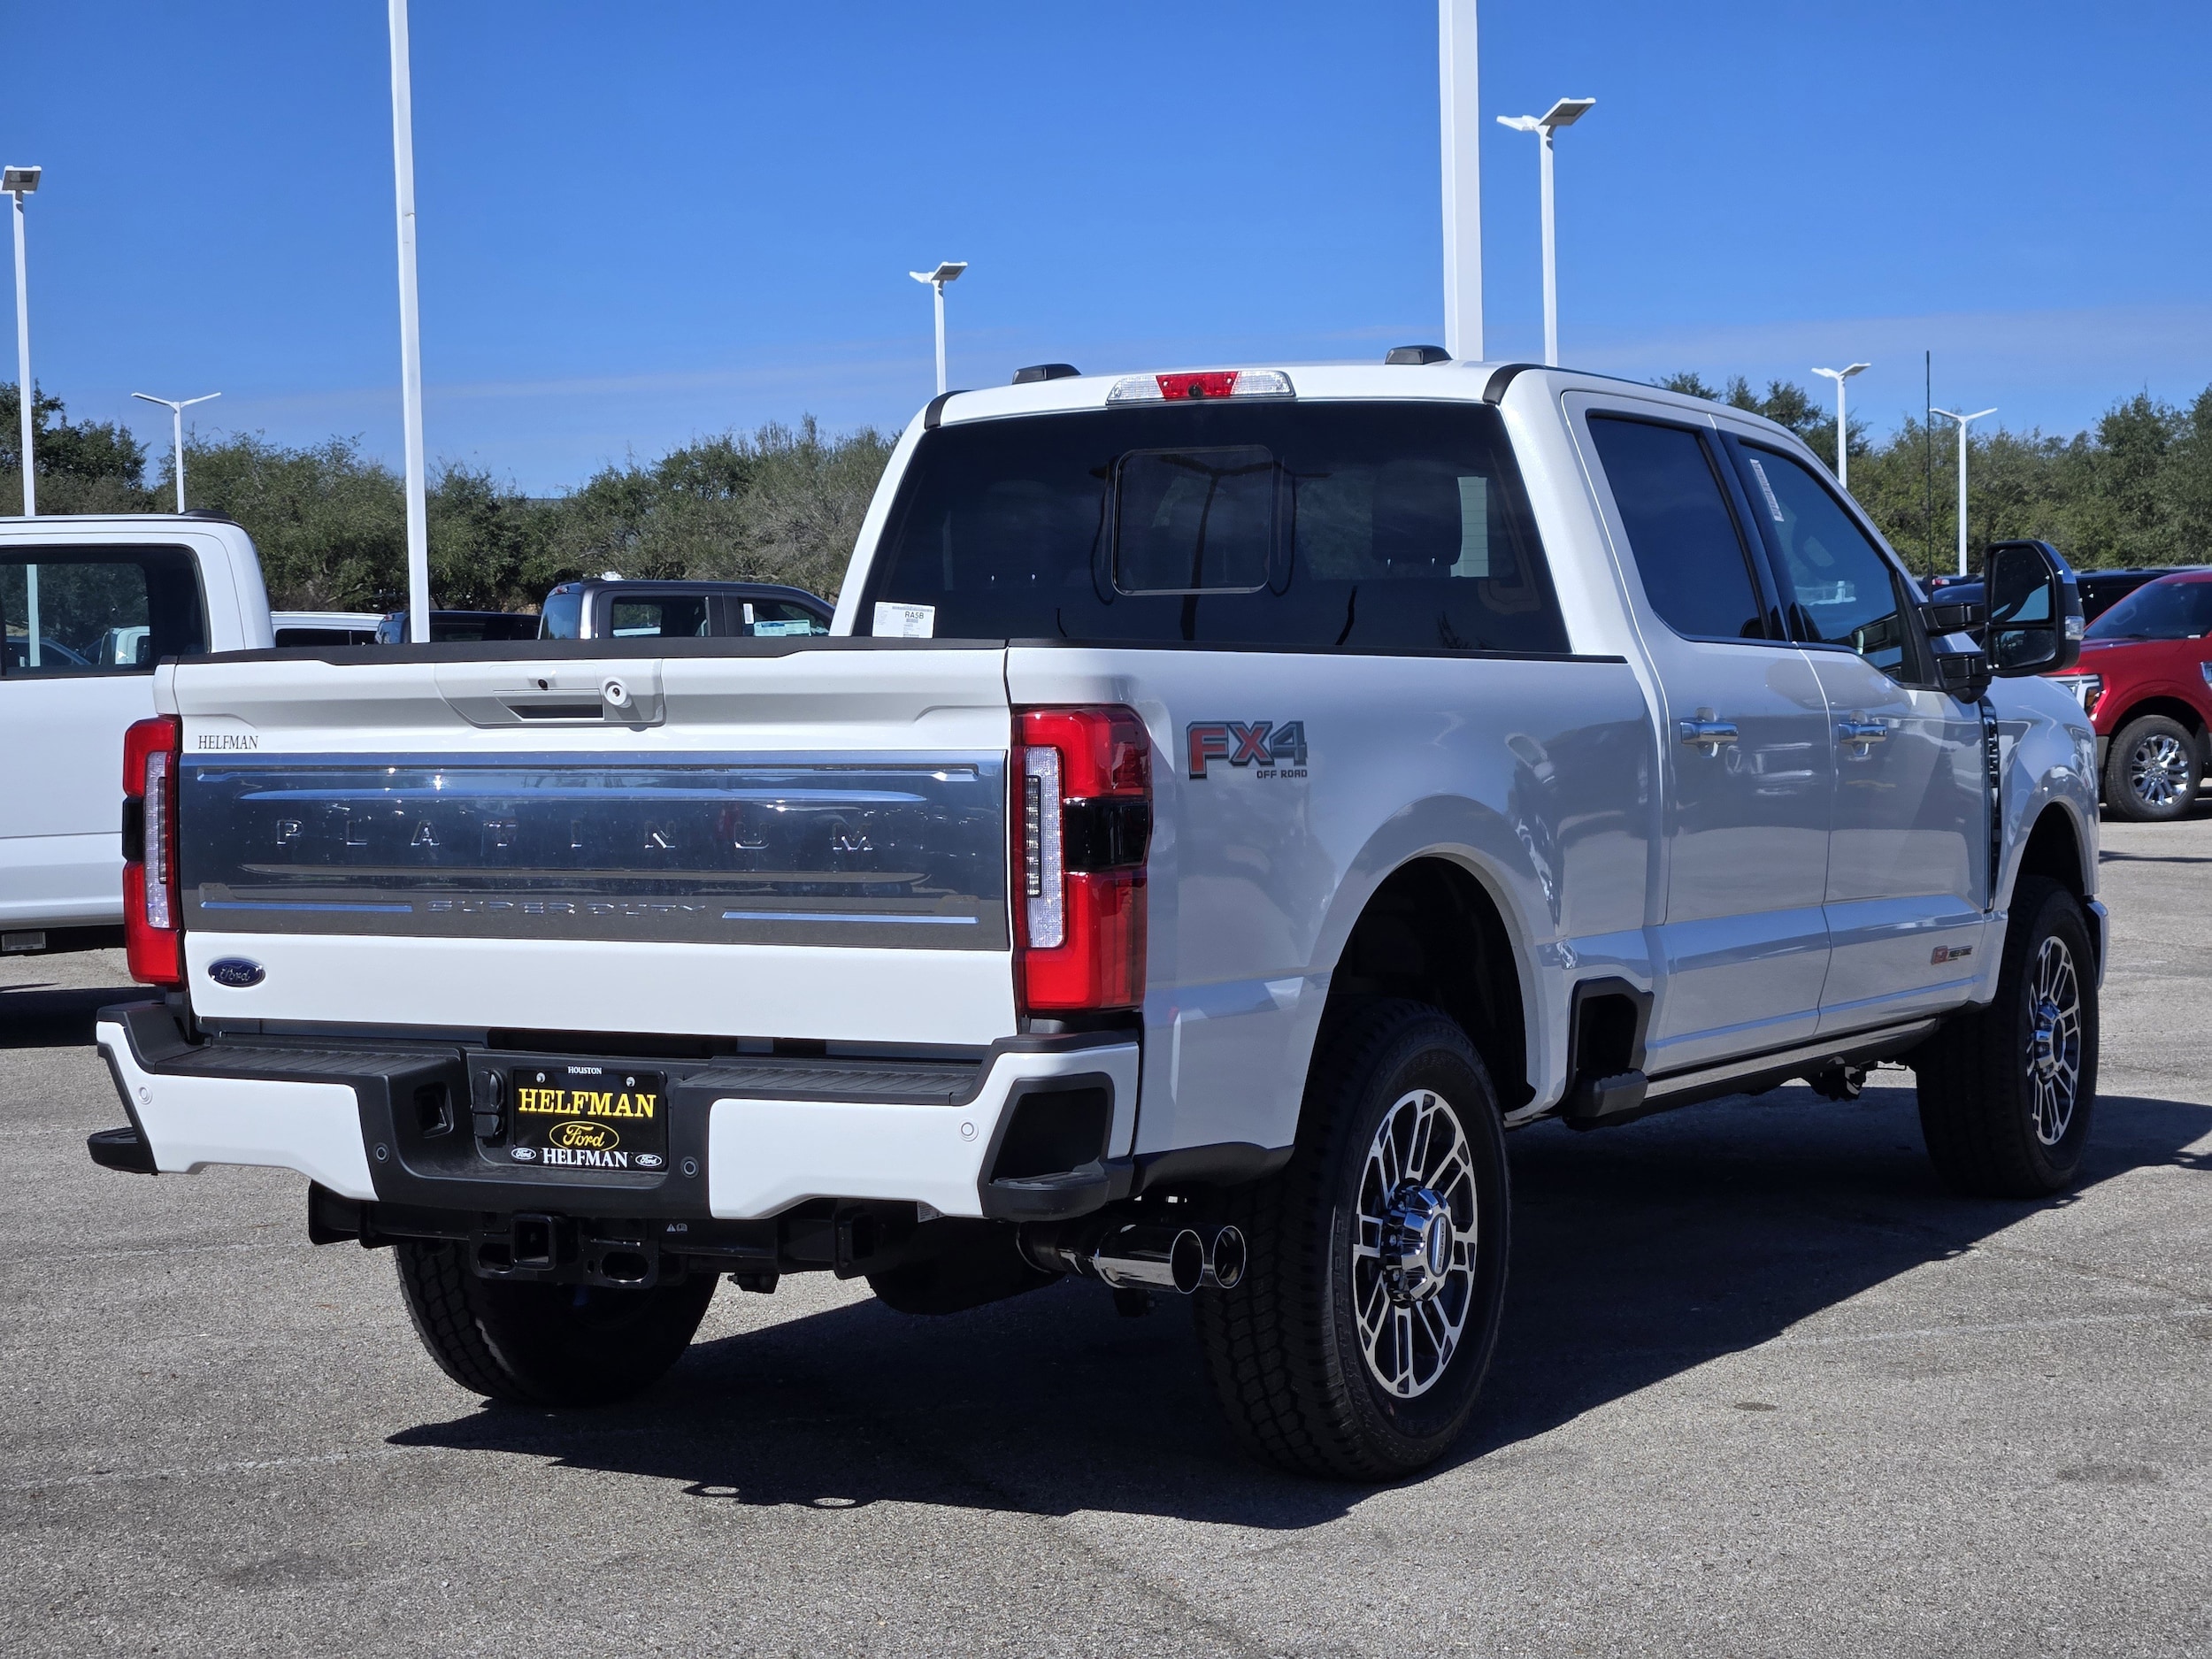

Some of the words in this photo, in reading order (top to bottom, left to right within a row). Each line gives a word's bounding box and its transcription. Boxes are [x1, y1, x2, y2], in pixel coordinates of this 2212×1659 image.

[197, 734, 258, 749] HELFMAN
[1187, 720, 1308, 780] FX4
[1280, 769, 1308, 779] ROAD
[276, 818, 874, 852] PLATINUM
[427, 900, 577, 916] SUPER
[586, 902, 707, 918] DUTY
[219, 964, 251, 981] Ford
[567, 1065, 603, 1076] HOUSTON
[518, 1087, 657, 1118] HELFMAN
[562, 1124, 605, 1148] Ford
[541, 1148, 629, 1168] HELFMAN
